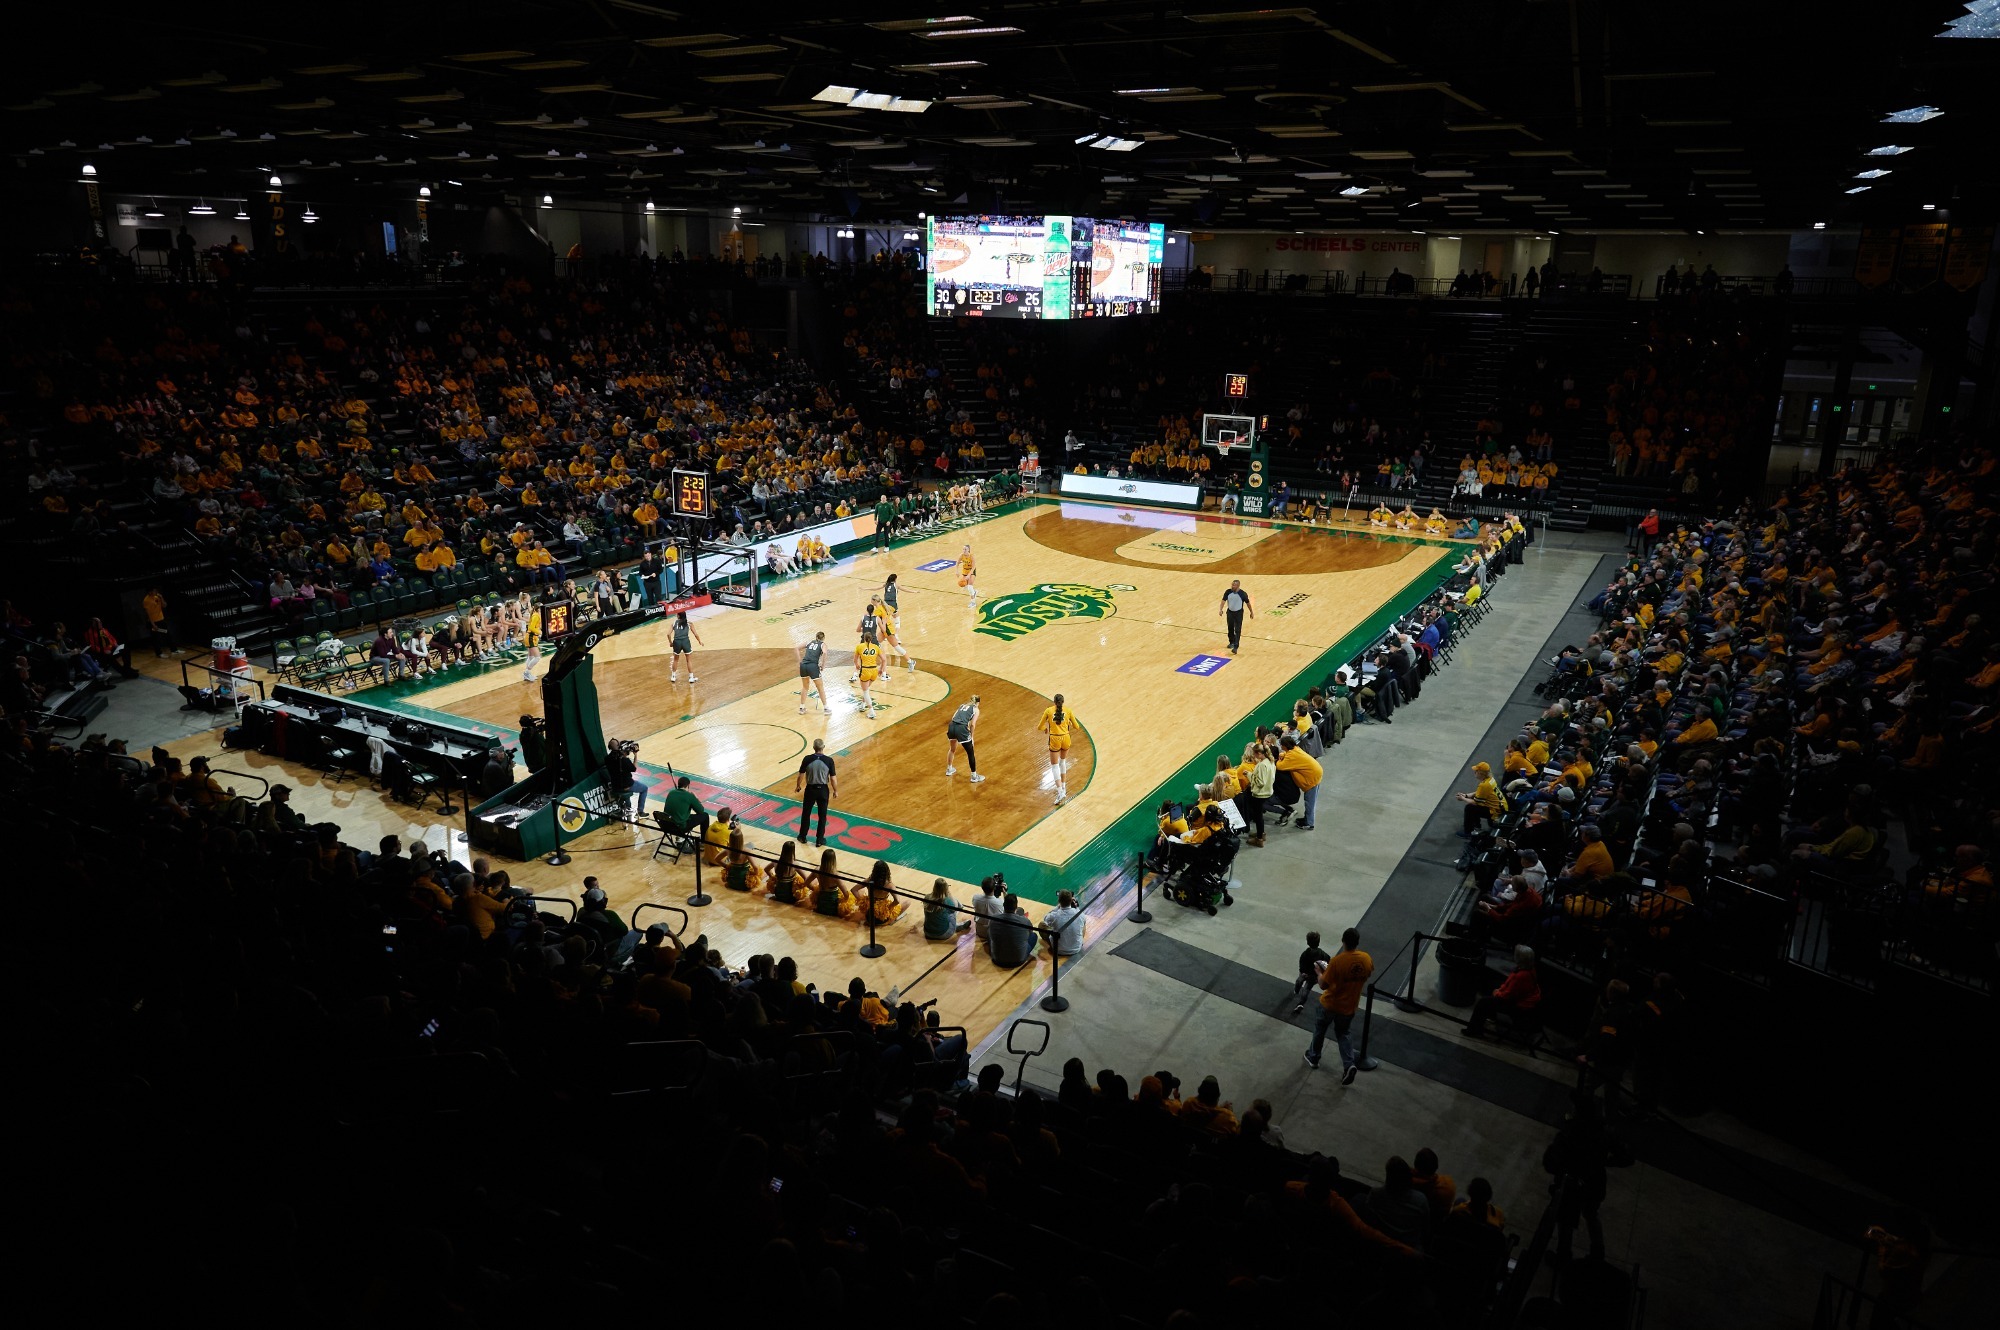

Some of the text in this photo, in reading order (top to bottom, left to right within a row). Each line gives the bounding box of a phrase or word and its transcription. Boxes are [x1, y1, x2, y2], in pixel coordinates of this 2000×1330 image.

[267, 193, 289, 253] NDSU
[1275, 237, 1420, 252] SCHEELS CENTER
[936, 289, 950, 303] 30
[974, 290, 994, 303] 2:23
[1025, 292, 1040, 306] 26
[1230, 383, 1243, 395] 23
[683, 476, 704, 490] 2:23
[681, 489, 702, 511] 23
[1243, 500, 1263, 508] WILD
[781, 599, 837, 617] PIONEER
[1277, 592, 1312, 610] PIONEER
[550, 606, 567, 617] 2:23
[972, 594, 1086, 642] NDSU
[549, 617, 565, 632] 23
[864, 620, 874, 628] 33
[863, 648, 876, 656] 40
